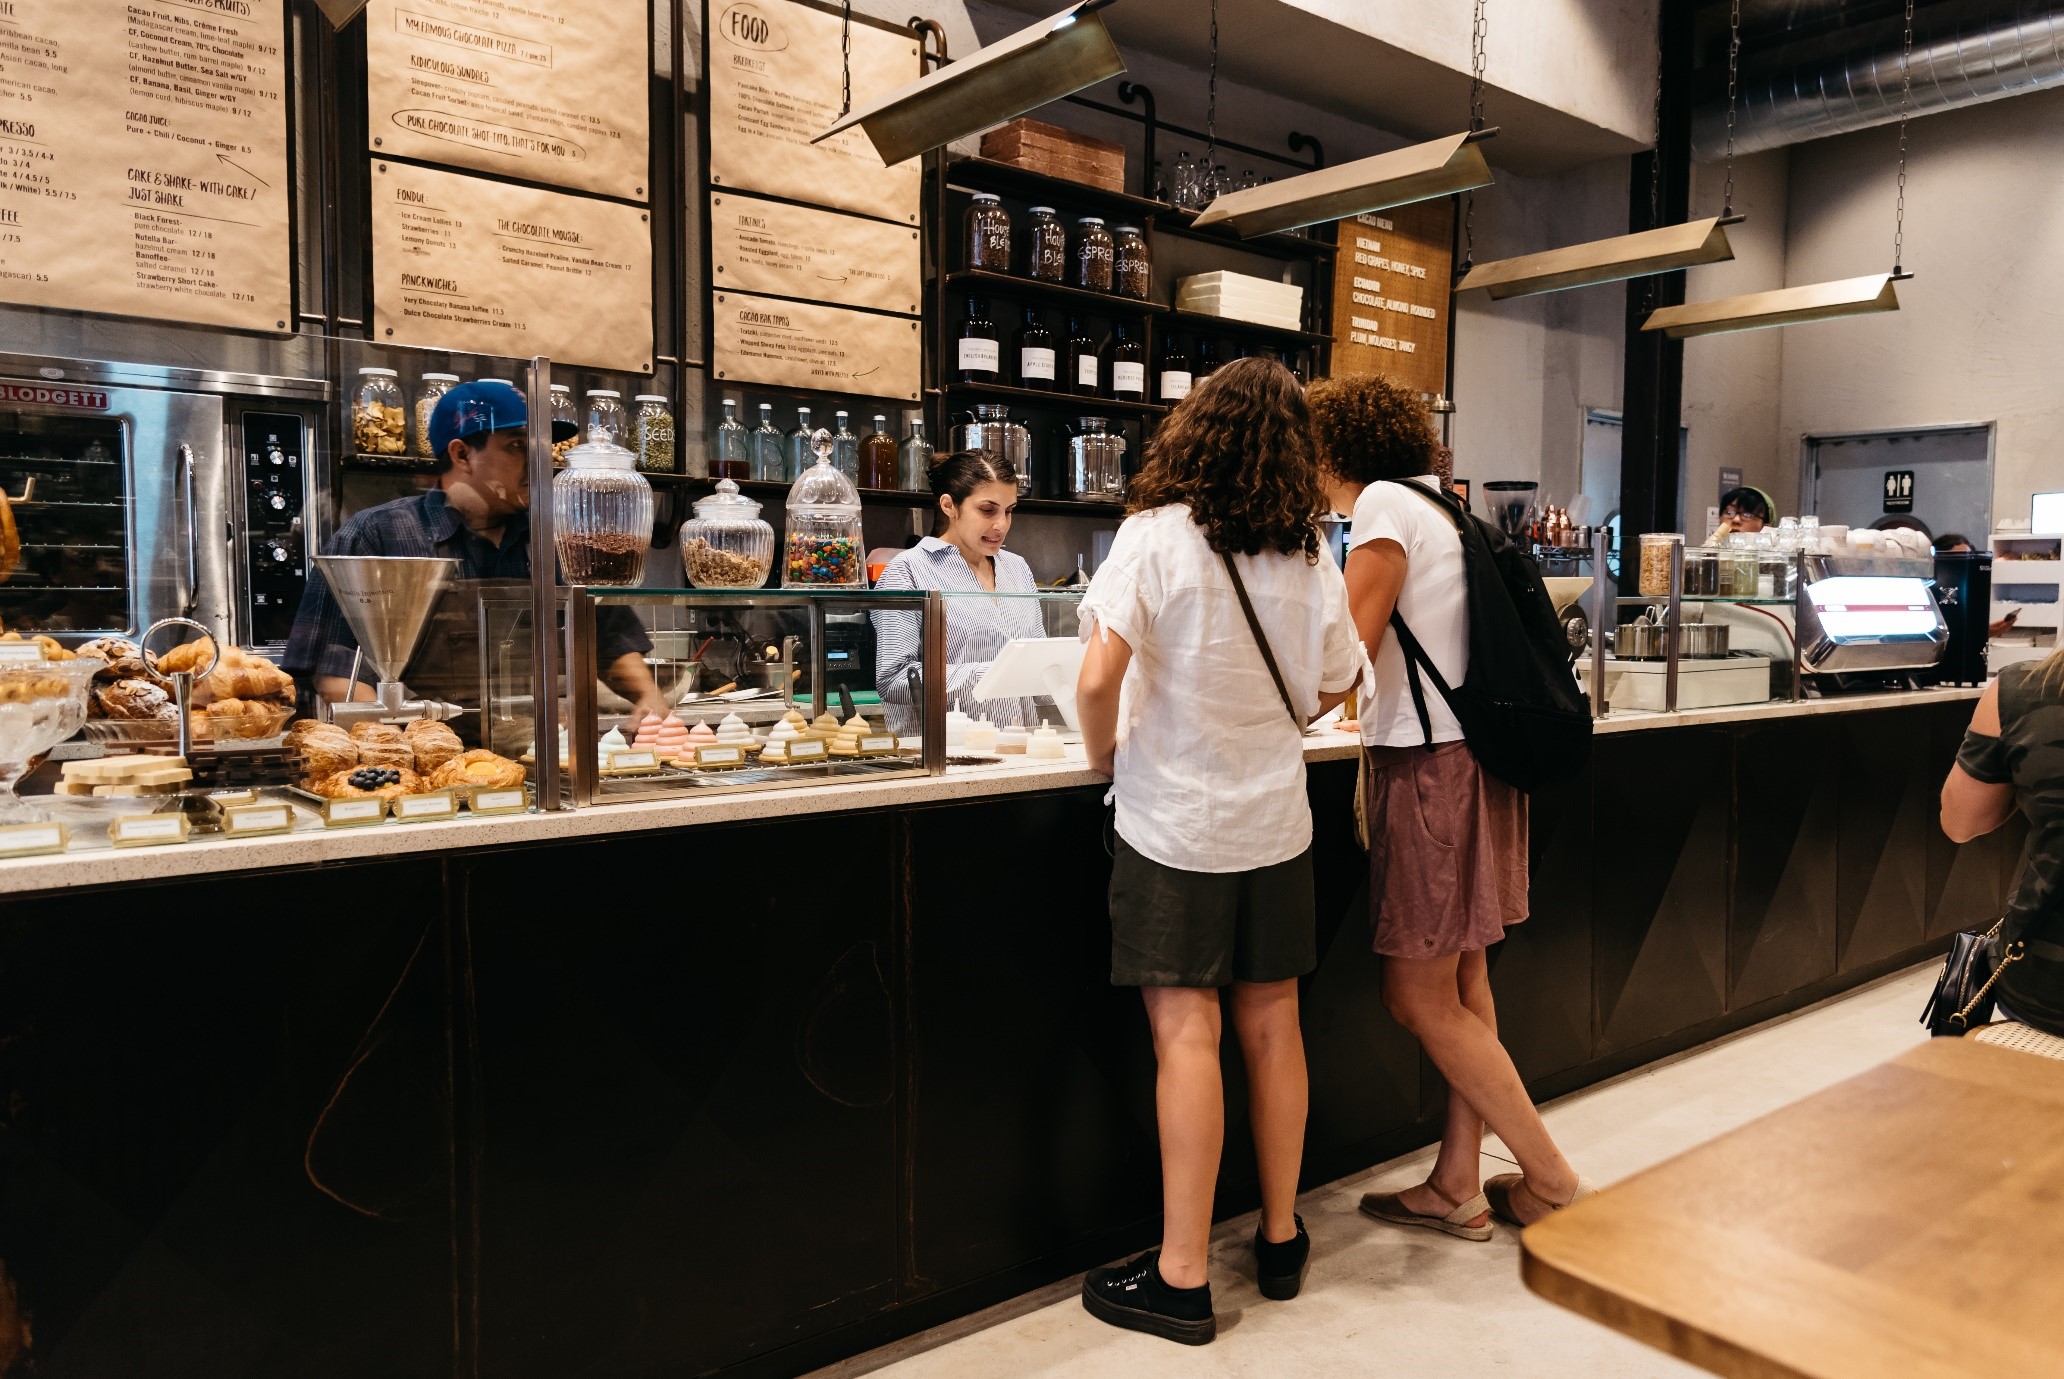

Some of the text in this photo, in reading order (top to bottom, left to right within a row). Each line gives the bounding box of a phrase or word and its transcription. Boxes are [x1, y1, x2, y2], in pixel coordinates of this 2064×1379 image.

[127, 5, 150, 16] Cacao
[174, 16, 192, 26] Nibs,
[218, 26, 238, 36] Fresh
[732, 11, 769, 45] FOOD
[140, 30, 168, 43] Coconut
[212, 46, 244, 59] Chocolate
[405, 18, 517, 55] MY FAMOUS CHOCOLATE PIZZA
[45, 49, 57, 58] 5.5
[142, 54, 174, 67] Hazelnut
[201, 67, 214, 76] Sea
[216, 69, 229, 78] Salt
[411, 55, 489, 83] RIDICULOUS SUNDAES
[143, 78, 172, 91] Banana,
[196, 88, 217, 99] Ginger
[412, 88, 430, 97] Cacao
[20, 93, 32, 102] 5.5
[126, 125, 237, 152] Pure Chili Coconut Ginger
[408, 115, 426, 129] PURE
[428, 118, 471, 137] CHOCOLATE
[536, 141, 550, 154] FOR
[552, 145, 565, 156] YOU
[128, 168, 152, 183] CAKE
[200, 181, 224, 195] WITH
[226, 184, 248, 200] CAKE
[128, 187, 184, 207] JUST SHAKE
[134, 213, 155, 222] Black
[413, 214, 432, 222] Cream
[1357, 214, 1393, 231] CACAO MENU
[134, 222, 184, 235] pure chocolate
[402, 223, 438, 235] Strawberries
[497, 219, 510, 231] THE
[512, 222, 550, 238] CHOCOLATE
[135, 233, 161, 243] Nutella
[426, 239, 446, 247] Donuts
[502, 245, 524, 255] Crunchy
[526, 249, 549, 258] Hazelnut
[502, 257, 520, 265] Salted
[1355, 251, 1367, 265] RED
[1410, 265, 1426, 279] SPICE
[136, 272, 176, 284] Strawberry
[178, 277, 196, 286] Short
[401, 273, 457, 292] PANCKWICHES
[1354, 276, 1380, 292] ECUADOR
[136, 282, 173, 292] strawberry
[195, 289, 226, 299] chocolate
[404, 296, 417, 304] Very
[449, 302, 470, 311] Banana
[404, 308, 511, 328] Dulce Chocolate Strawberries Cream
[740, 311, 758, 322] CACAO
[772, 315, 790, 327] TAPAS
[0, 386, 102, 407] BLODGETT
